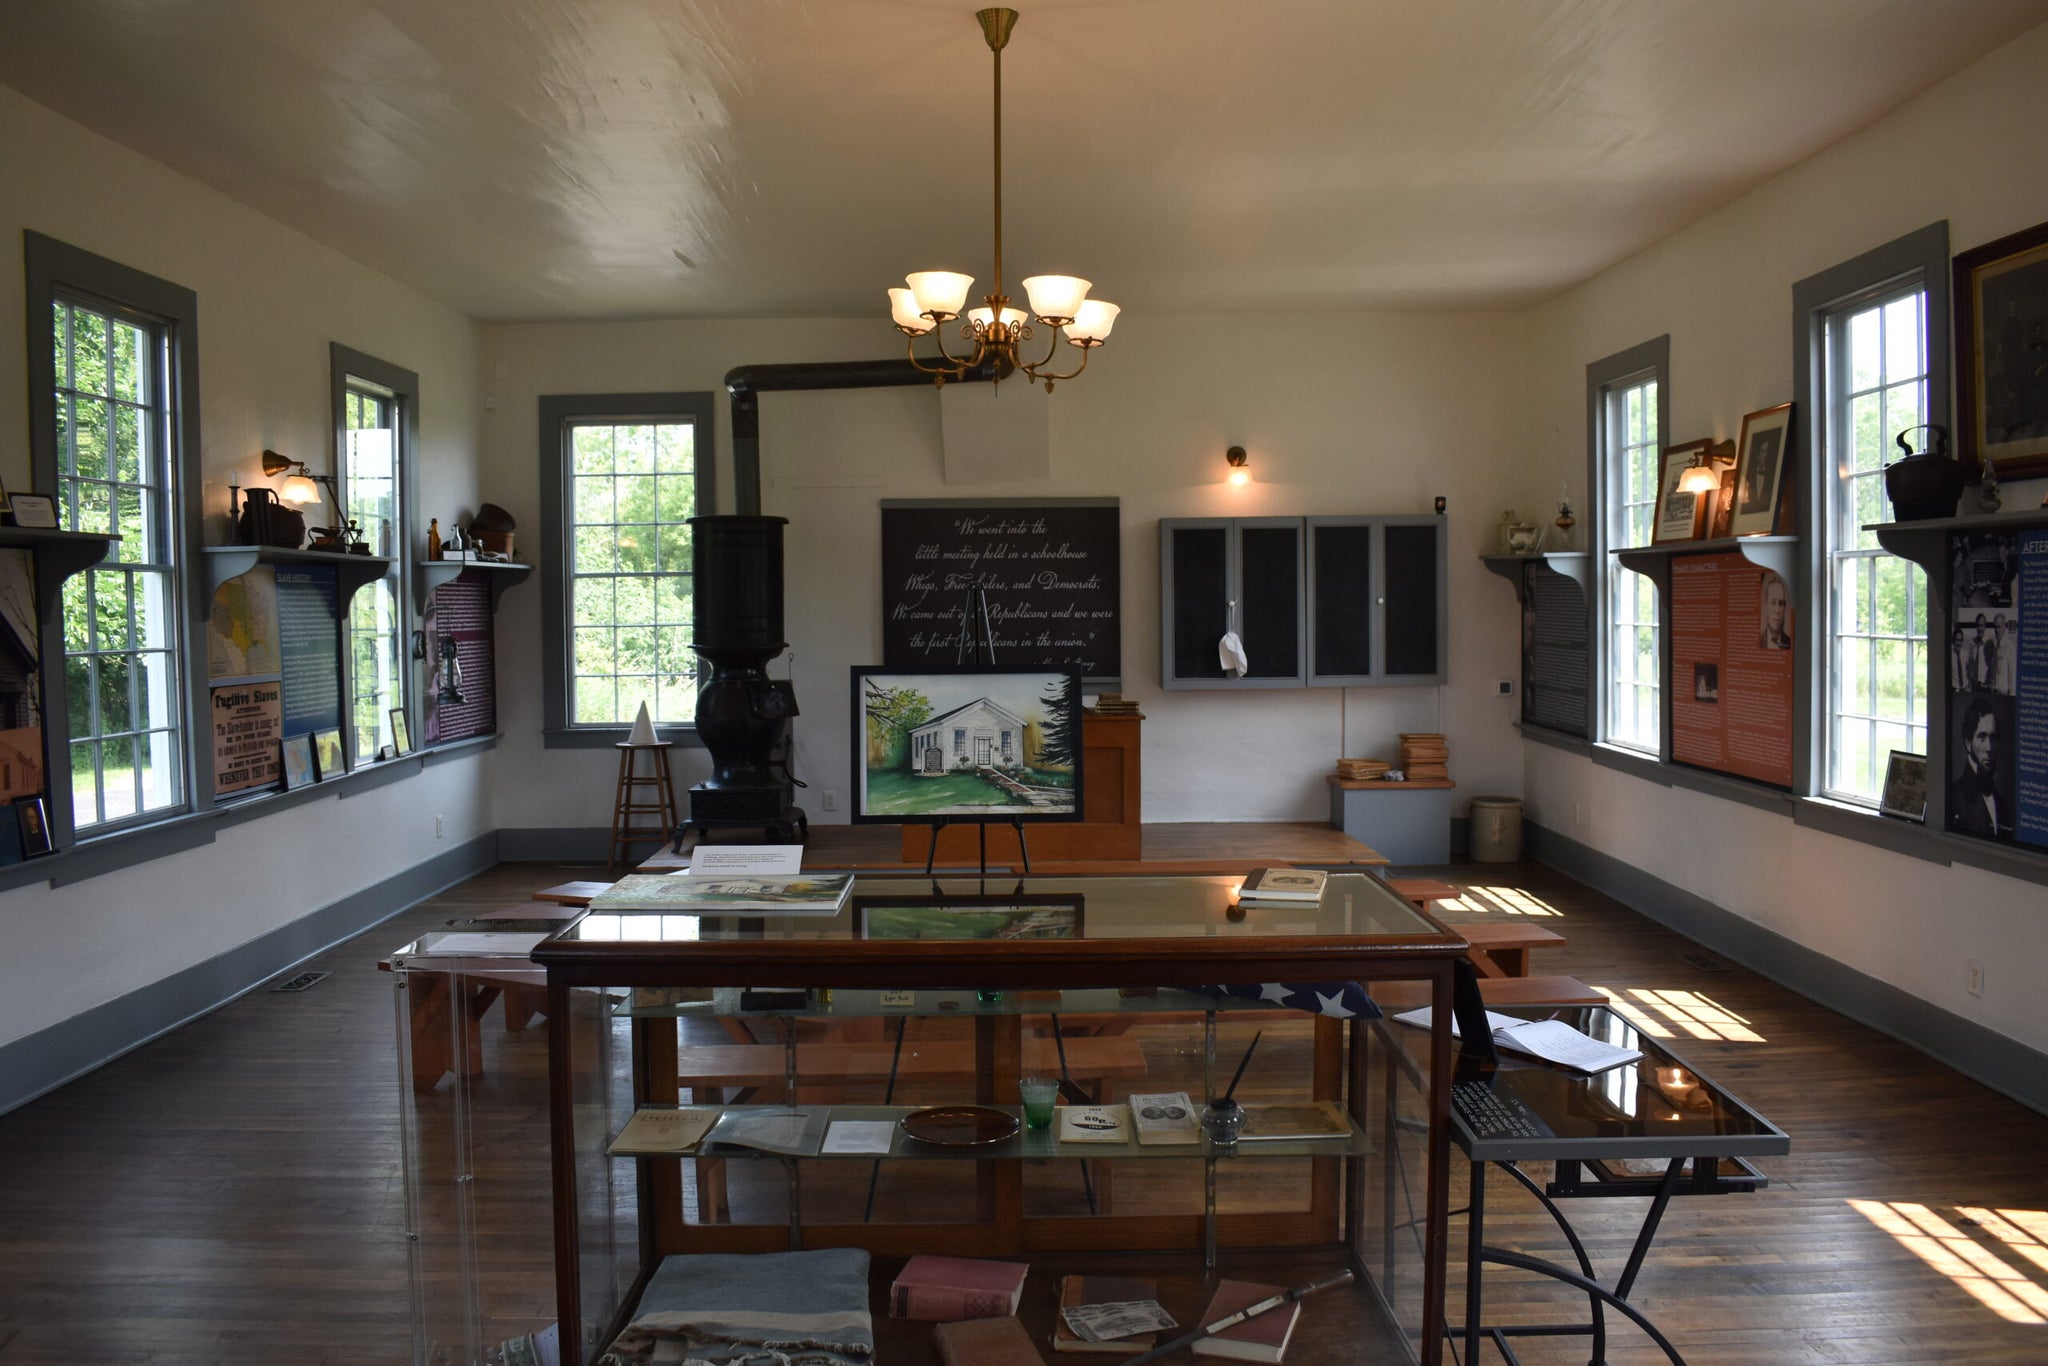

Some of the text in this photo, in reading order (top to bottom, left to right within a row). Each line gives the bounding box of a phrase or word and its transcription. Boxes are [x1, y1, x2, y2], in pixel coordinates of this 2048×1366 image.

[979, 521, 1005, 535] went
[1007, 520, 1028, 535] into
[1031, 518, 1047, 535] the
[915, 543, 1088, 569] little meeting held in a schoolhouse
[904, 571, 938, 599] Whigs,
[1012, 574, 1035, 590] and
[1038, 571, 1102, 590] Democrats.
[890, 602, 921, 621] We
[910, 610, 934, 620] came
[938, 606, 958, 620] out
[988, 603, 1048, 625] Republicans
[1052, 603, 1074, 619] and
[1075, 611, 1088, 619] we
[1092, 611, 1114, 619] were
[910, 632, 925, 648] the
[925, 632, 951, 655] first
[1021, 633, 1032, 648] in
[1037, 632, 1052, 648] the
[215, 690, 278, 710] Fugitive Slaves
[219, 769, 250, 785] WHENEVER
